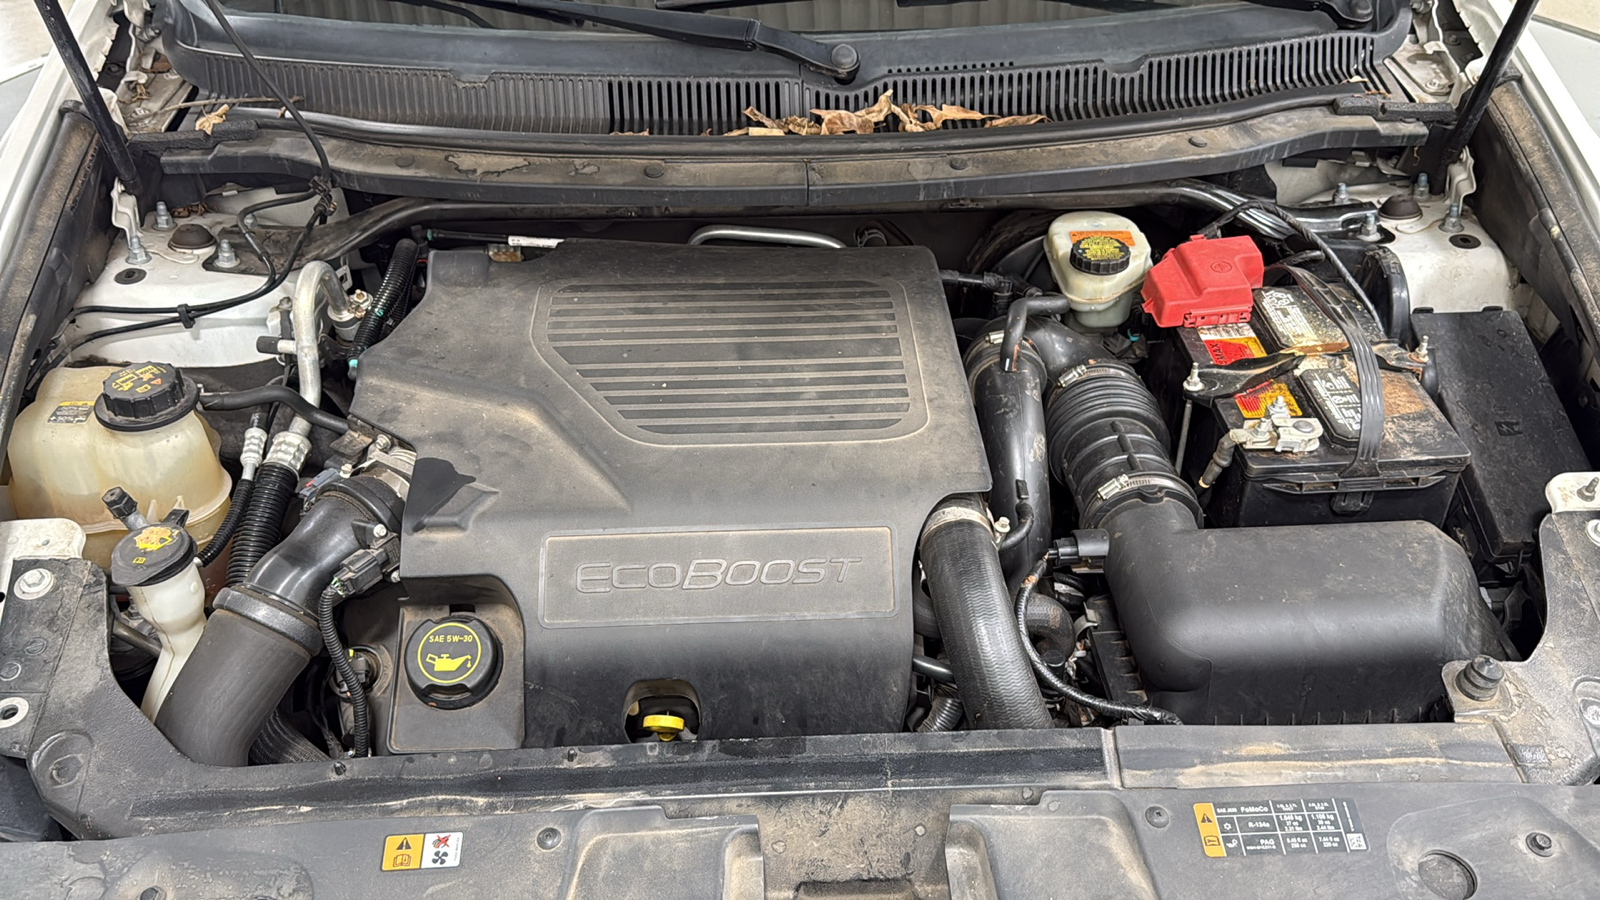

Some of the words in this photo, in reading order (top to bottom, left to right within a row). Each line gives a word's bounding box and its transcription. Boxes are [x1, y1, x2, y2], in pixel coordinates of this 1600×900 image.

[429, 634, 445, 643] SAE
[446, 634, 473, 643] 5W-30
[1240, 805, 1269, 813] FoMoCo
